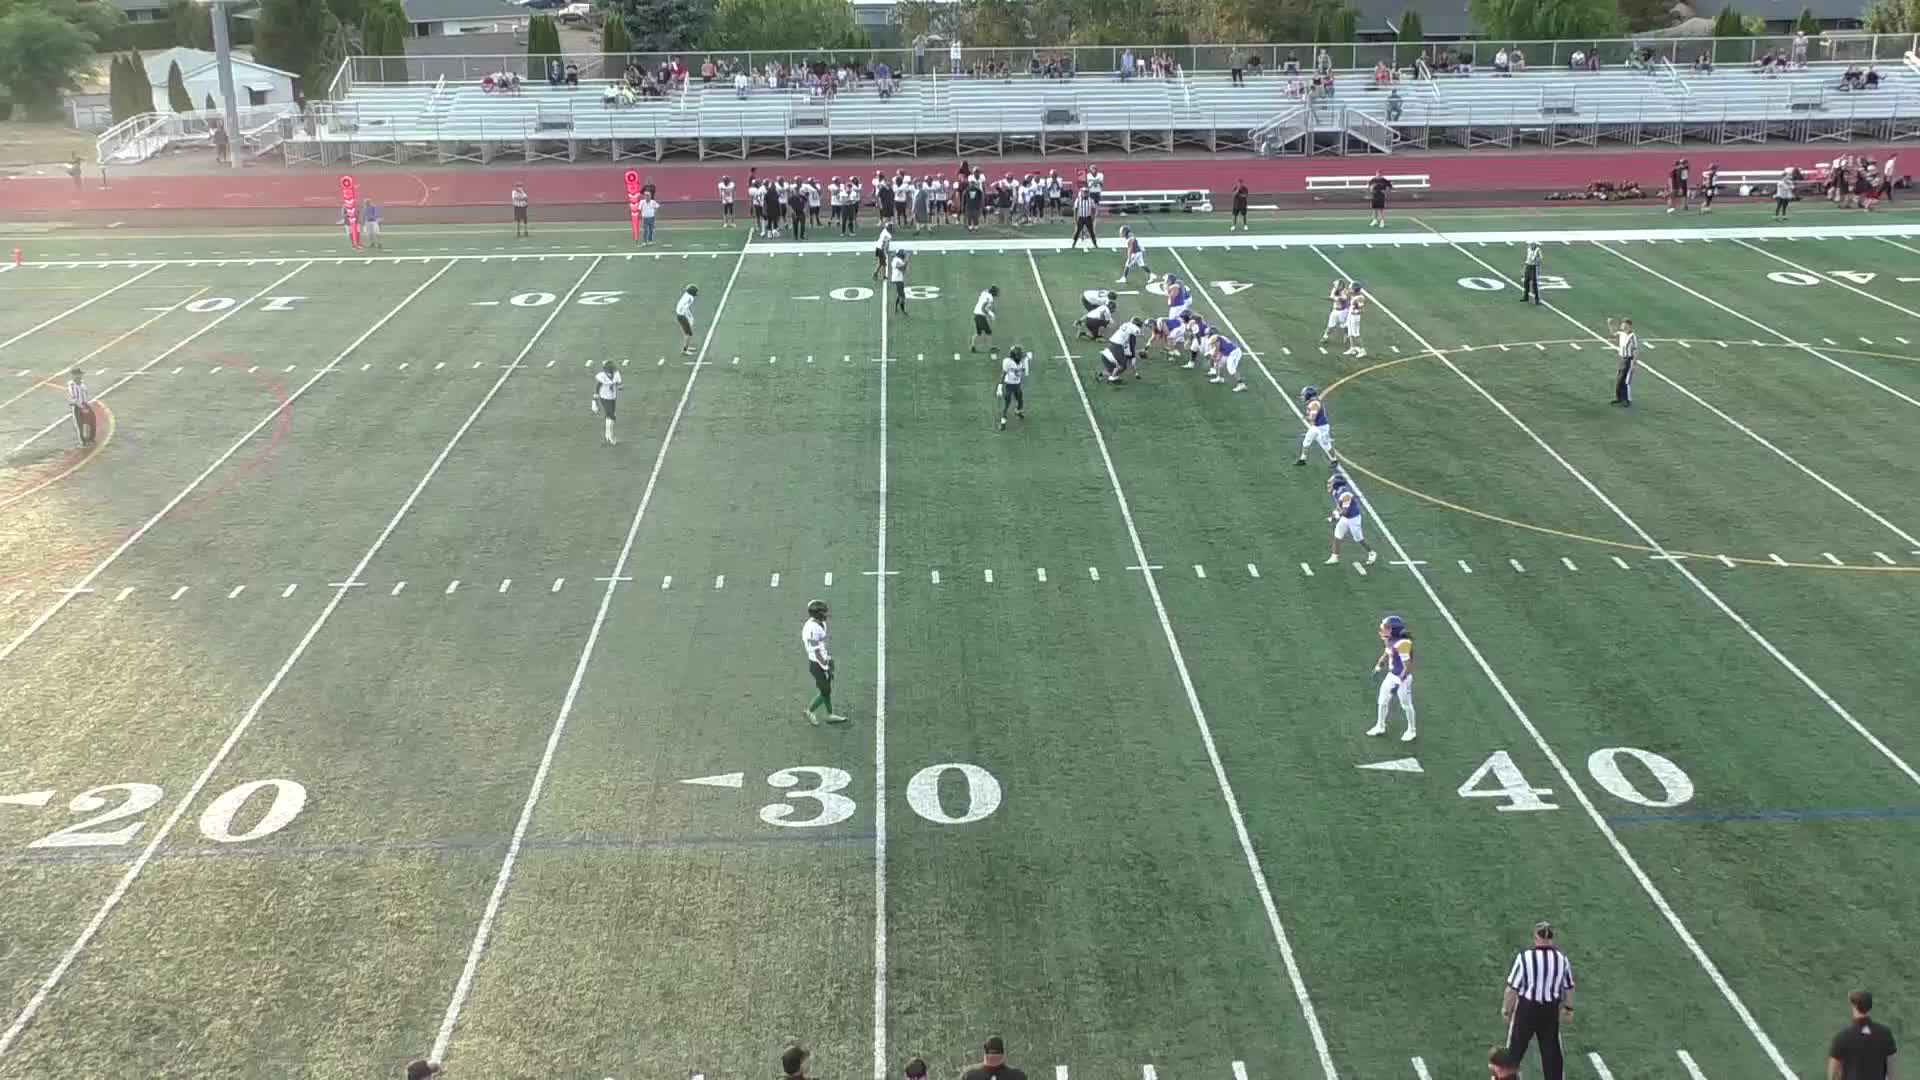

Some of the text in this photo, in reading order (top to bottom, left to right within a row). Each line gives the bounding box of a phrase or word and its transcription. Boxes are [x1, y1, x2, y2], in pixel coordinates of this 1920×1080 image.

[759, 763, 1002, 827] 30
[1456, 746, 1695, 812] 40
[27, 778, 308, 848] 20
